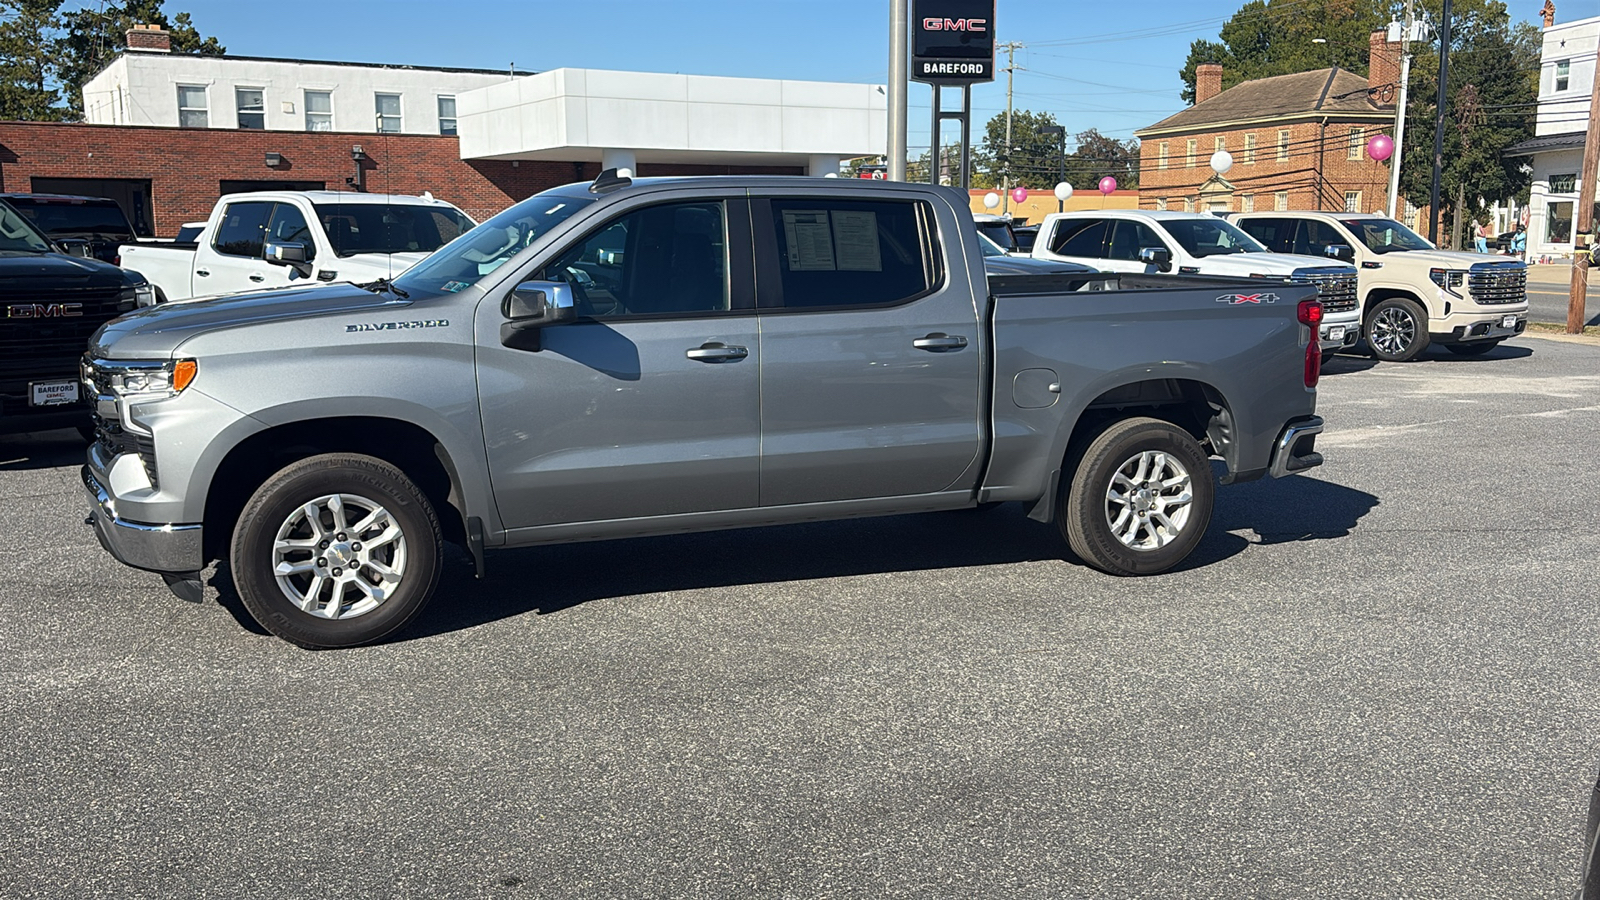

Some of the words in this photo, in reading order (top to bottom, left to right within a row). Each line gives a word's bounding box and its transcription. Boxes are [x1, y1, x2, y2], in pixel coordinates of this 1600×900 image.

[923, 17, 986, 31] GMC
[923, 63, 983, 74] BAREFORD
[7, 302, 83, 318] GMC
[345, 319, 449, 332] SILVERADO
[38, 385, 74, 393] BAREFORD
